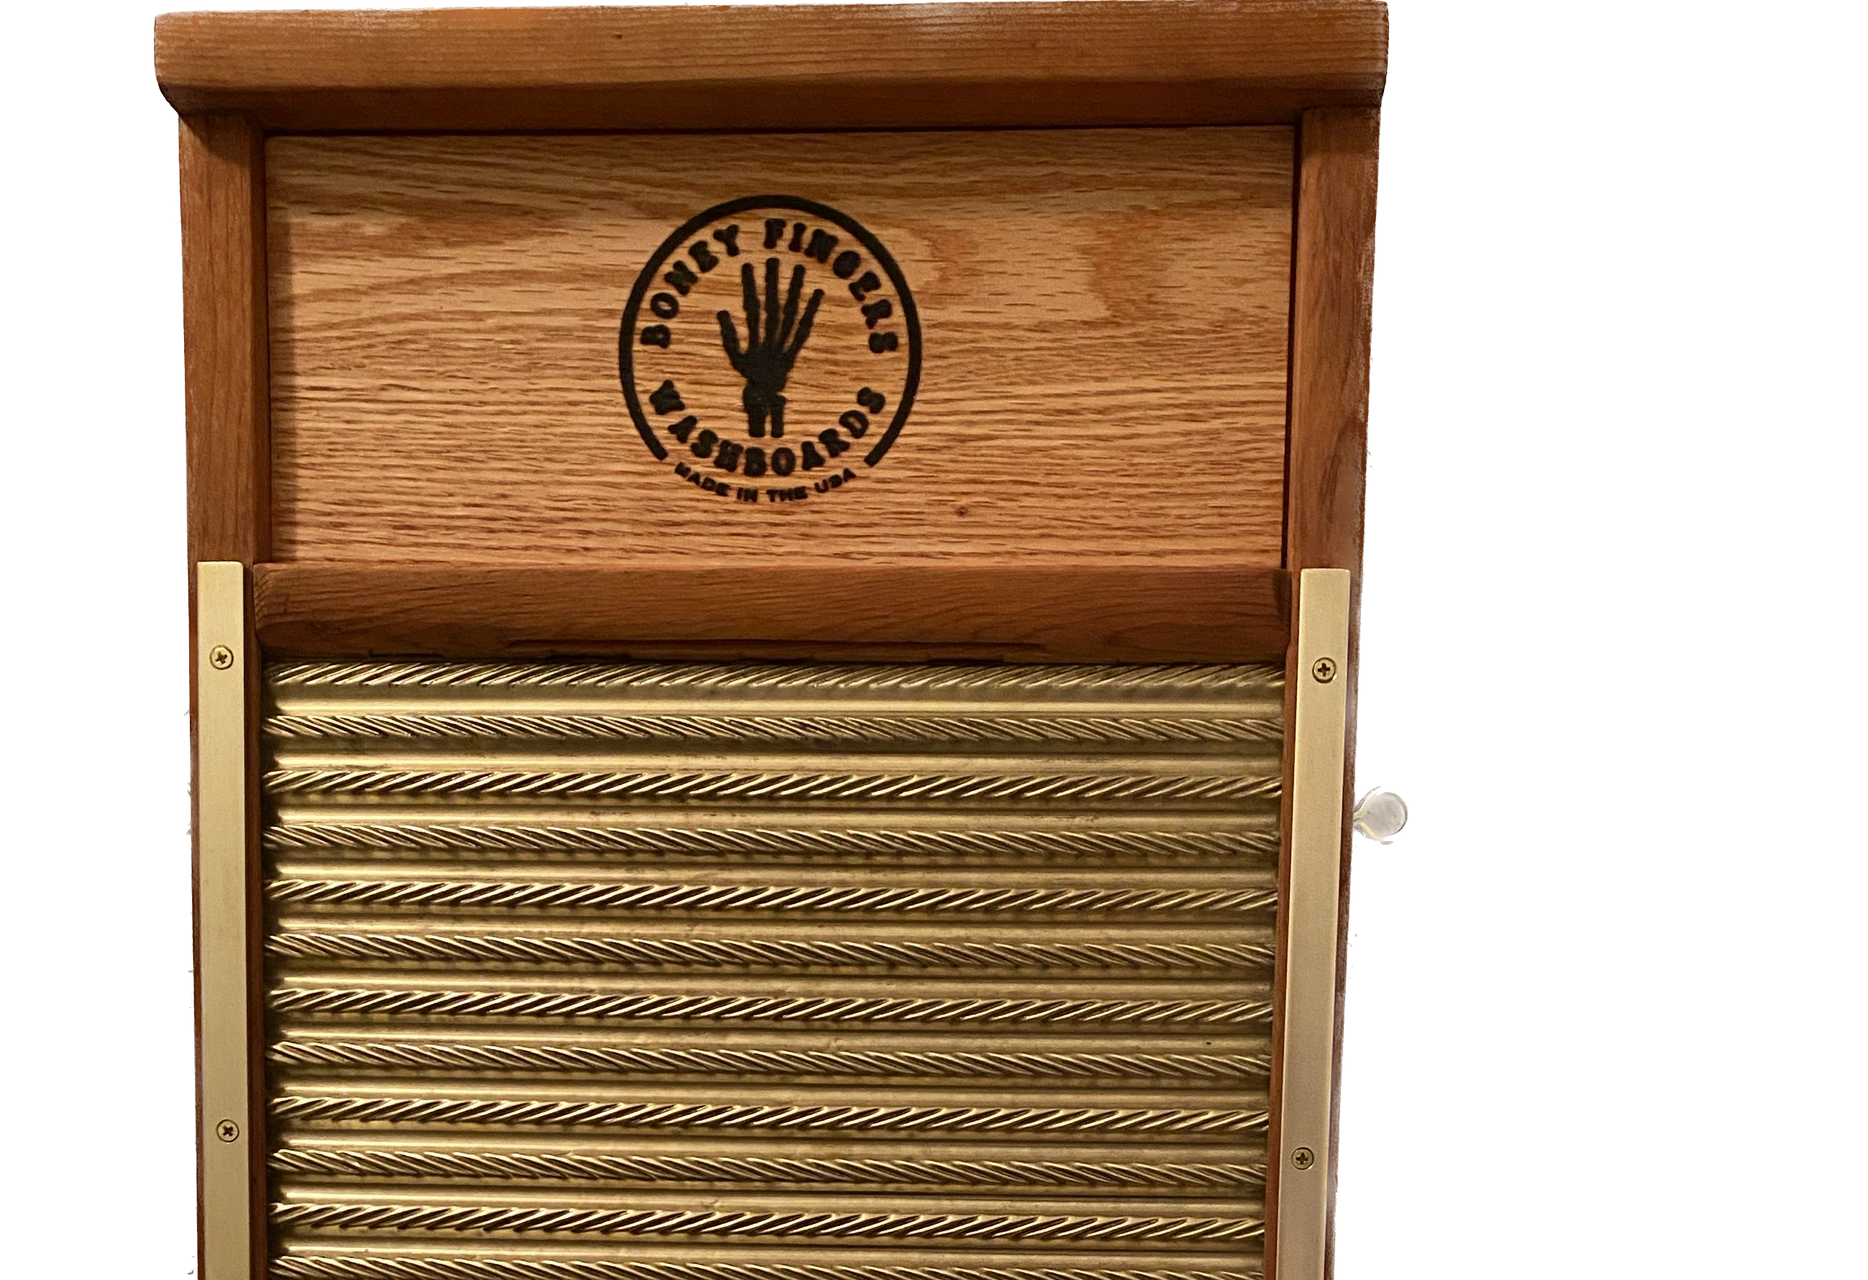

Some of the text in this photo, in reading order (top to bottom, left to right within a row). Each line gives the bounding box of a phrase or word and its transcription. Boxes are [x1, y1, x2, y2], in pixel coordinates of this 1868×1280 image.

[640, 224, 740, 349] BONEY
[649, 379, 886, 477] WASHBOARDS
[674, 462, 857, 502] MADE IN THE USA
